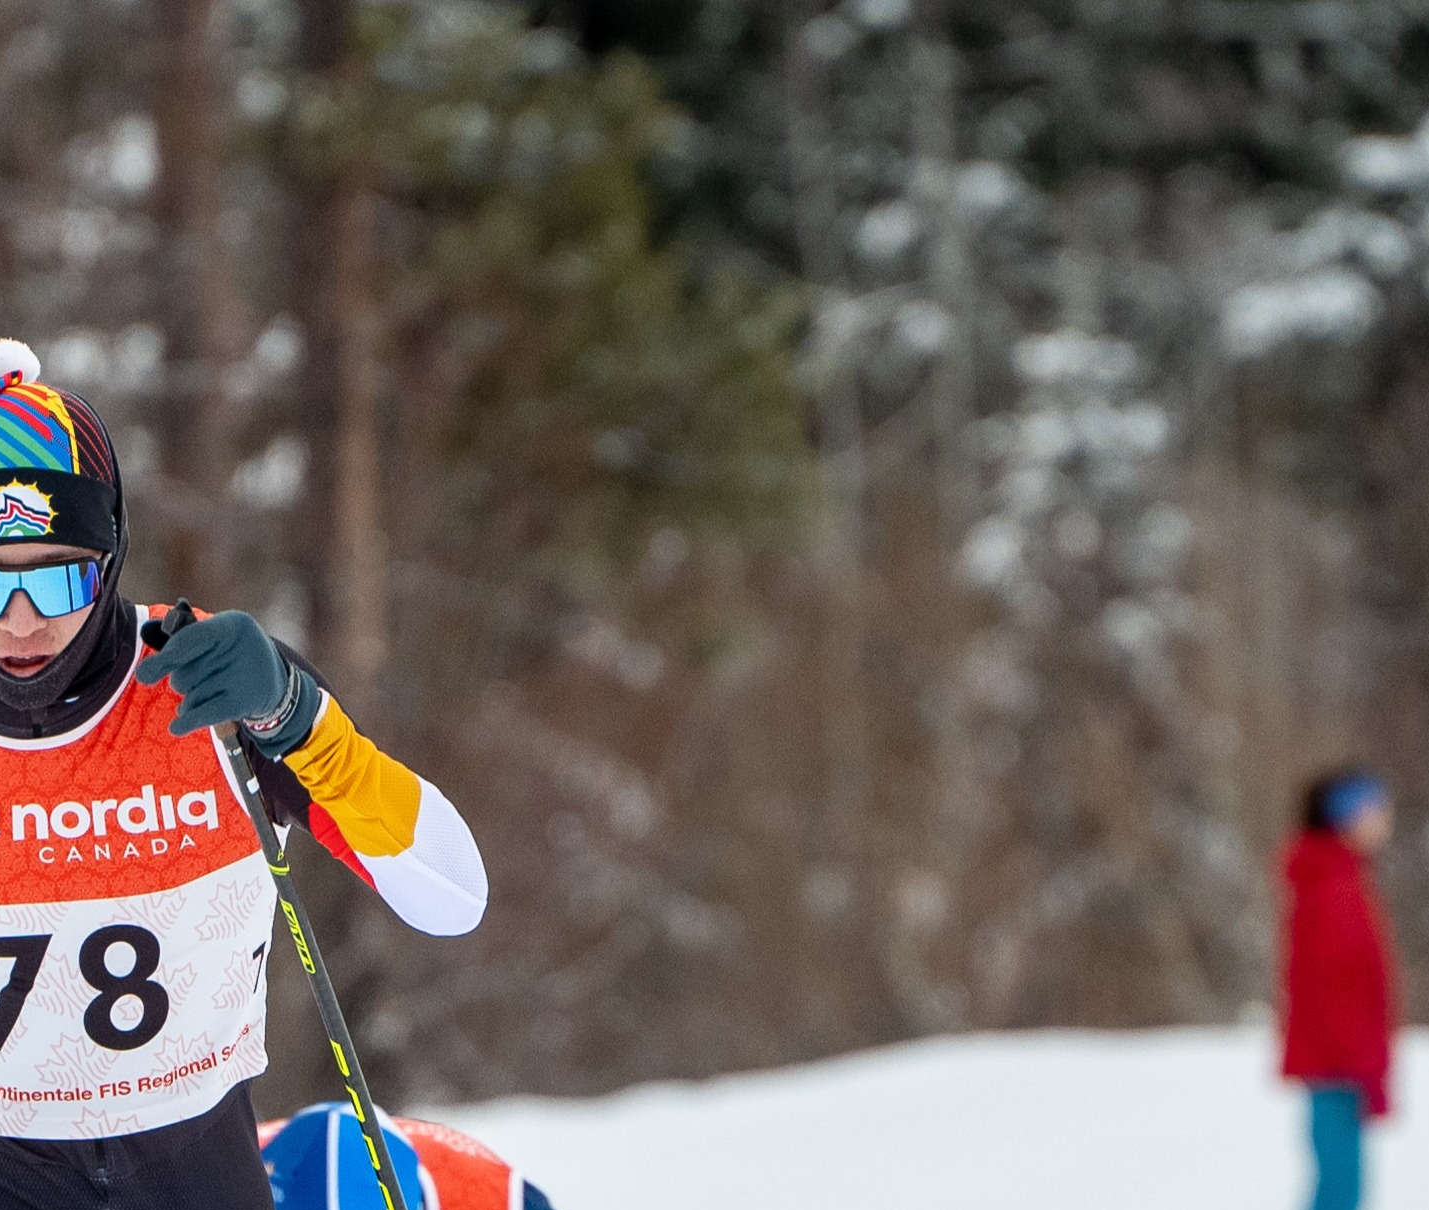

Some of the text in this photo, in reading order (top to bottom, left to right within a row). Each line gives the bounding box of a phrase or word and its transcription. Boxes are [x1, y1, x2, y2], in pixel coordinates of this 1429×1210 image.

[12, 785, 218, 841] nordiq
[38, 834, 196, 864] CANADA
[99, 1081, 131, 1099] FIS
[138, 1052, 217, 1092] Regional
